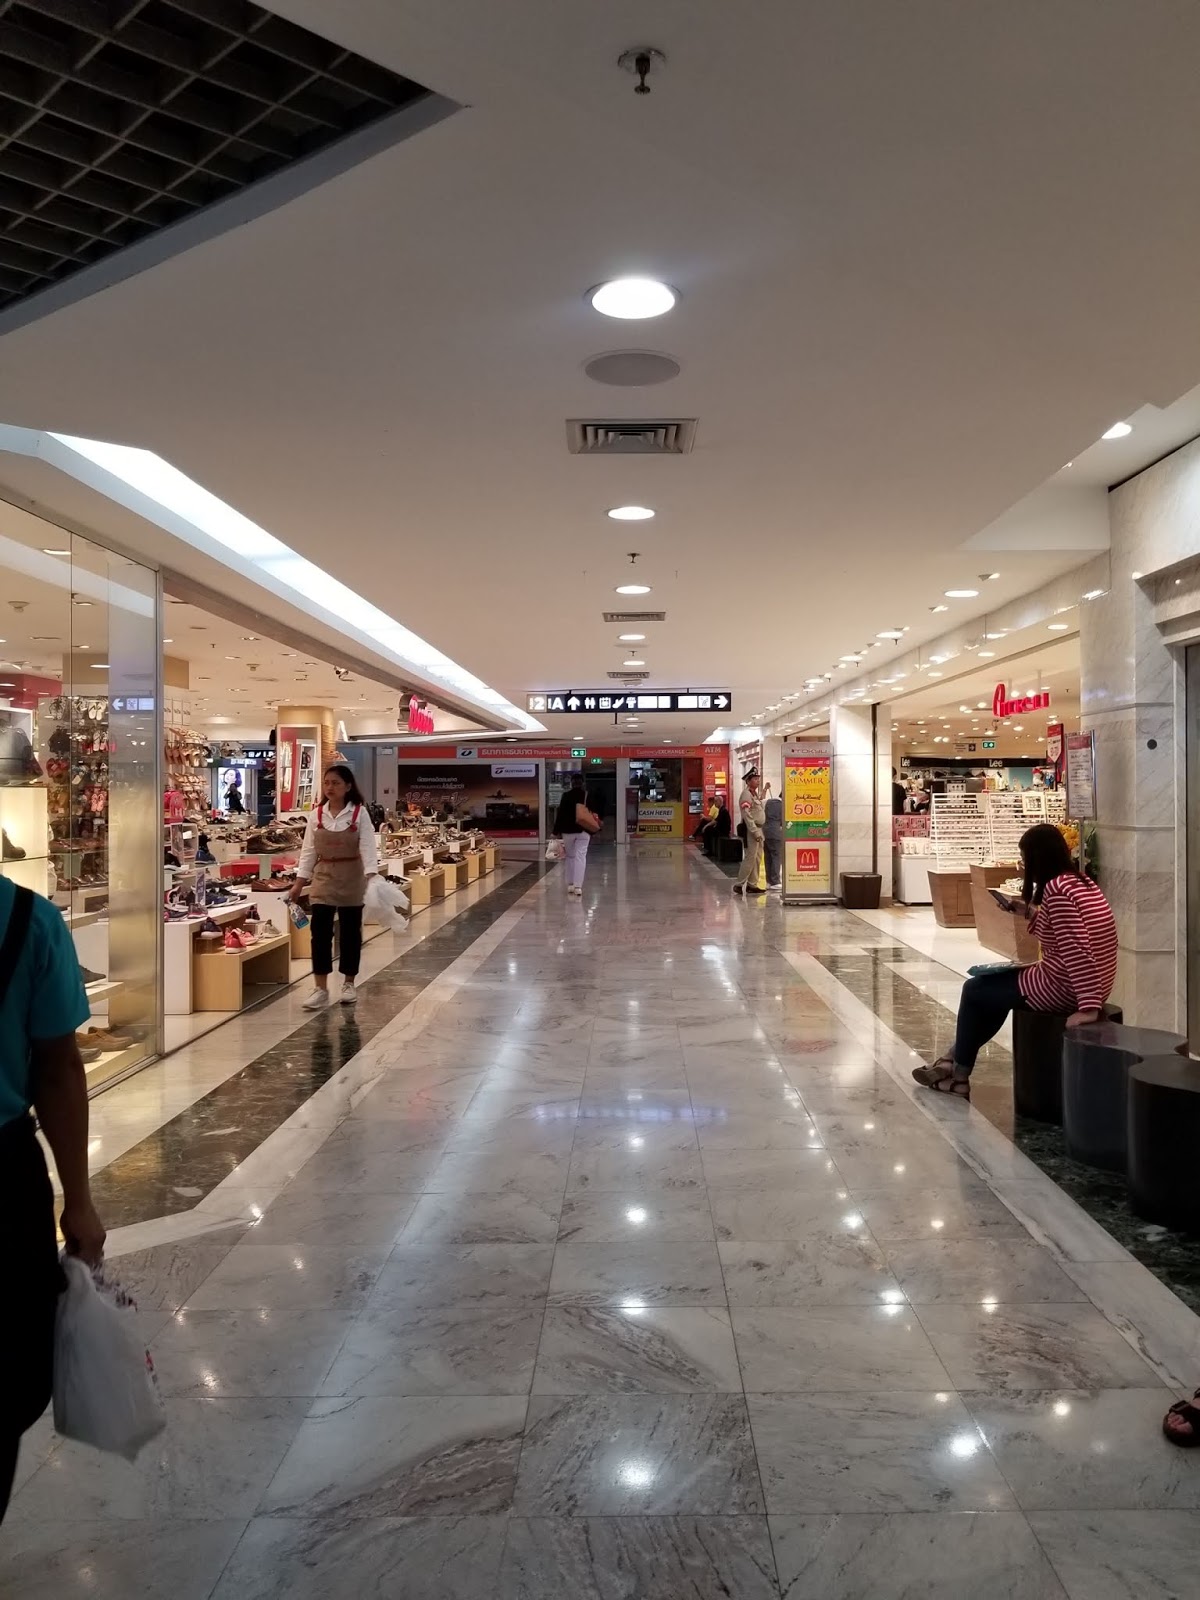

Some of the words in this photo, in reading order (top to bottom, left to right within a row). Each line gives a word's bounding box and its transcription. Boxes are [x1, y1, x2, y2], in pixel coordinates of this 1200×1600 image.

[901, 758, 911, 767] Lee
[989, 759, 1003, 767] Lee
[788, 777, 825, 786] SUMMER
